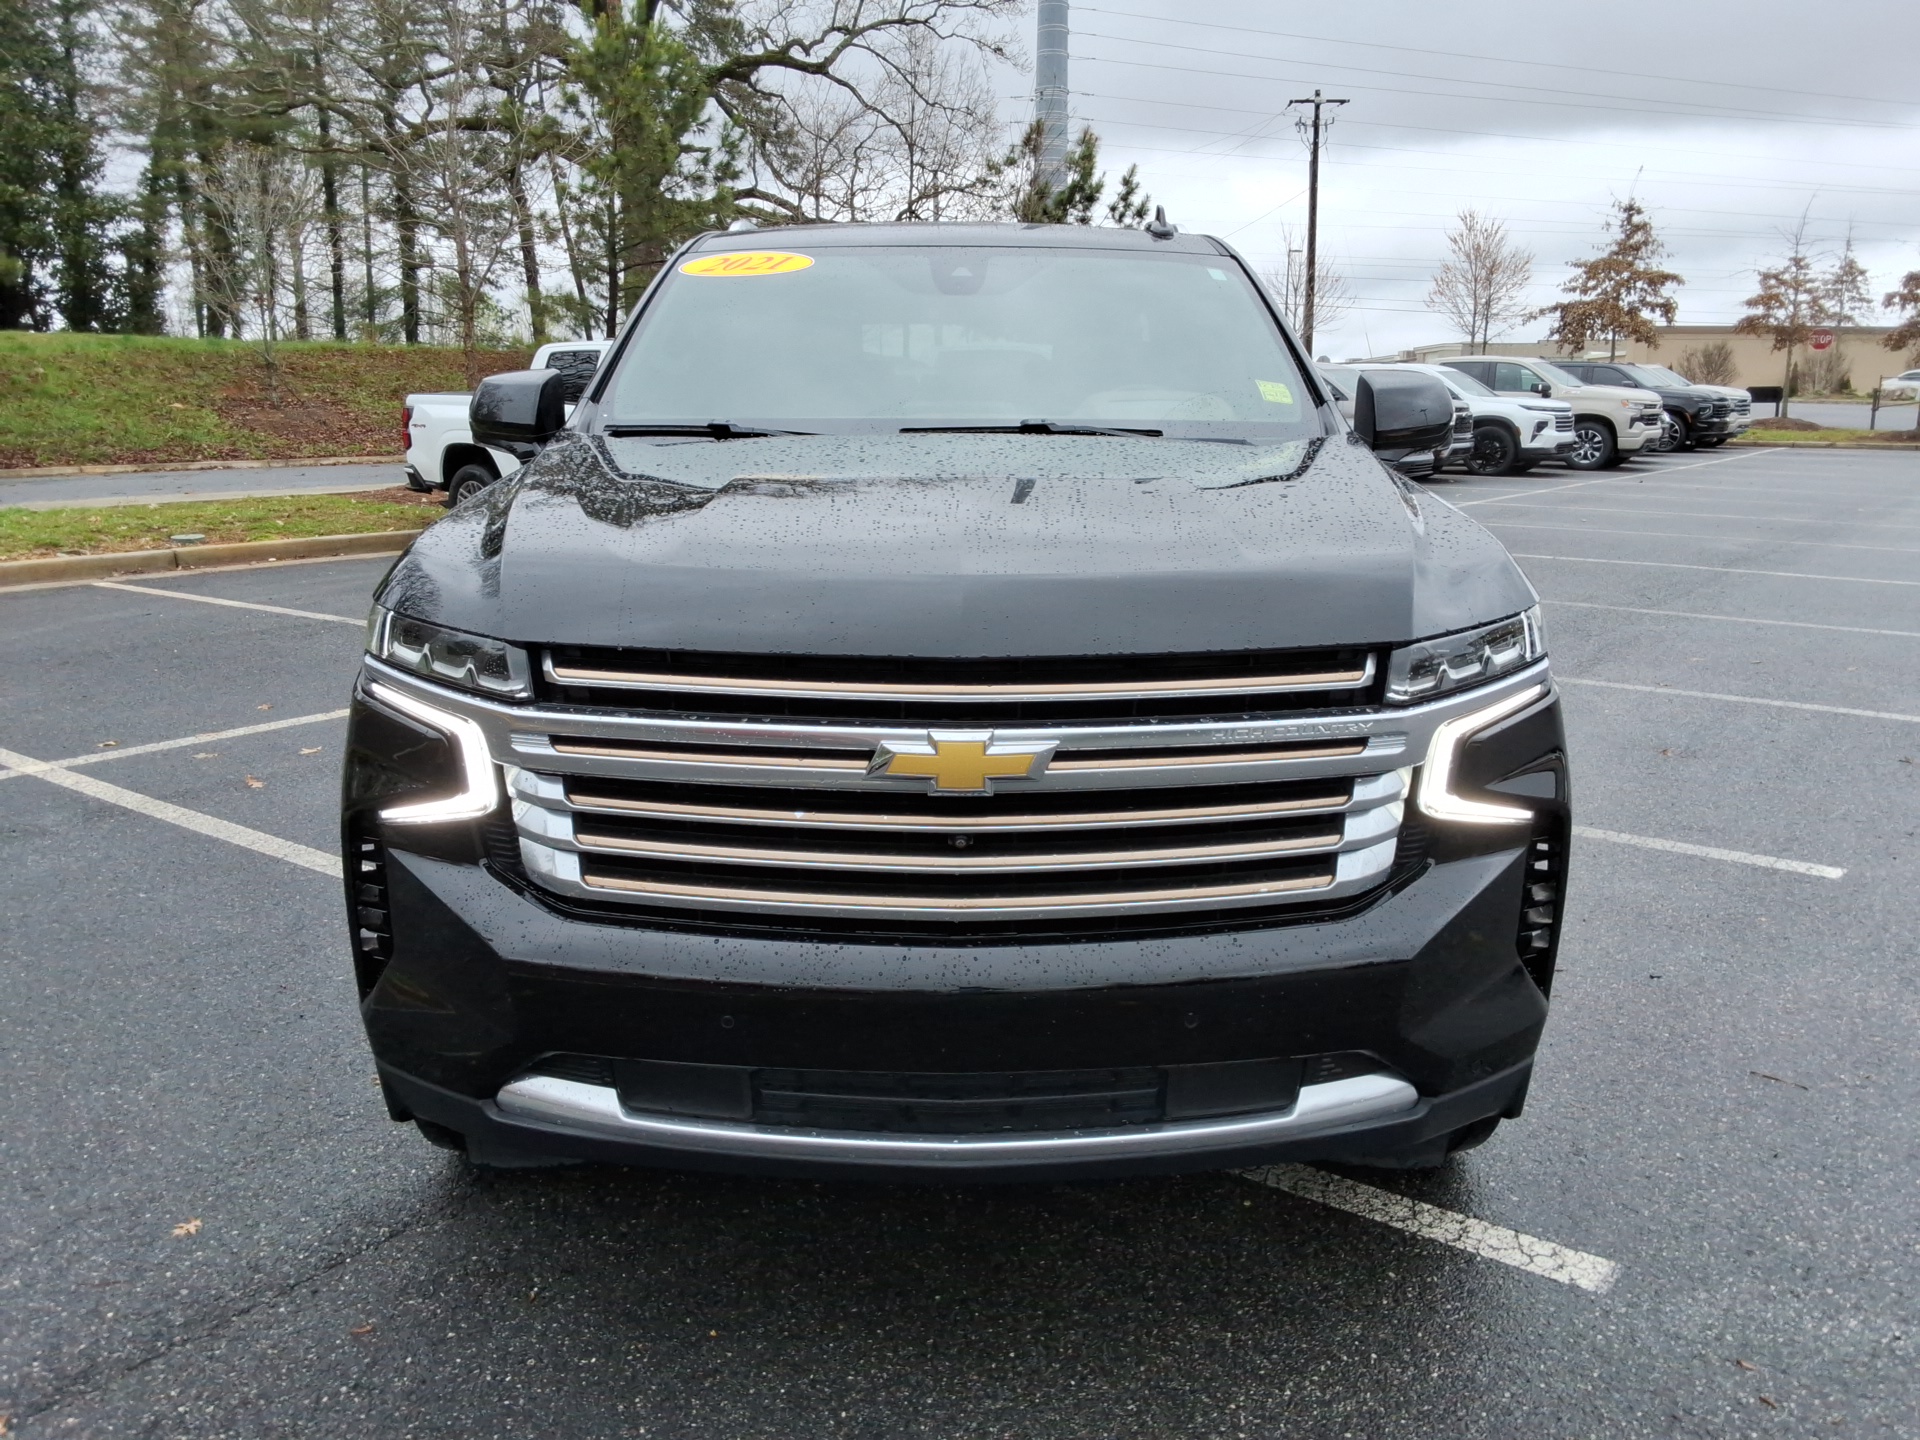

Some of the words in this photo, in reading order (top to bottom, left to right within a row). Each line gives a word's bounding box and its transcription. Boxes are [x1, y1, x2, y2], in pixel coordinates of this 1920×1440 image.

[698, 256, 794, 273] 2021
[1810, 335, 1832, 344] STOP
[1211, 728, 1266, 740] HIGH
[1272, 721, 1374, 737] COUNTRY
